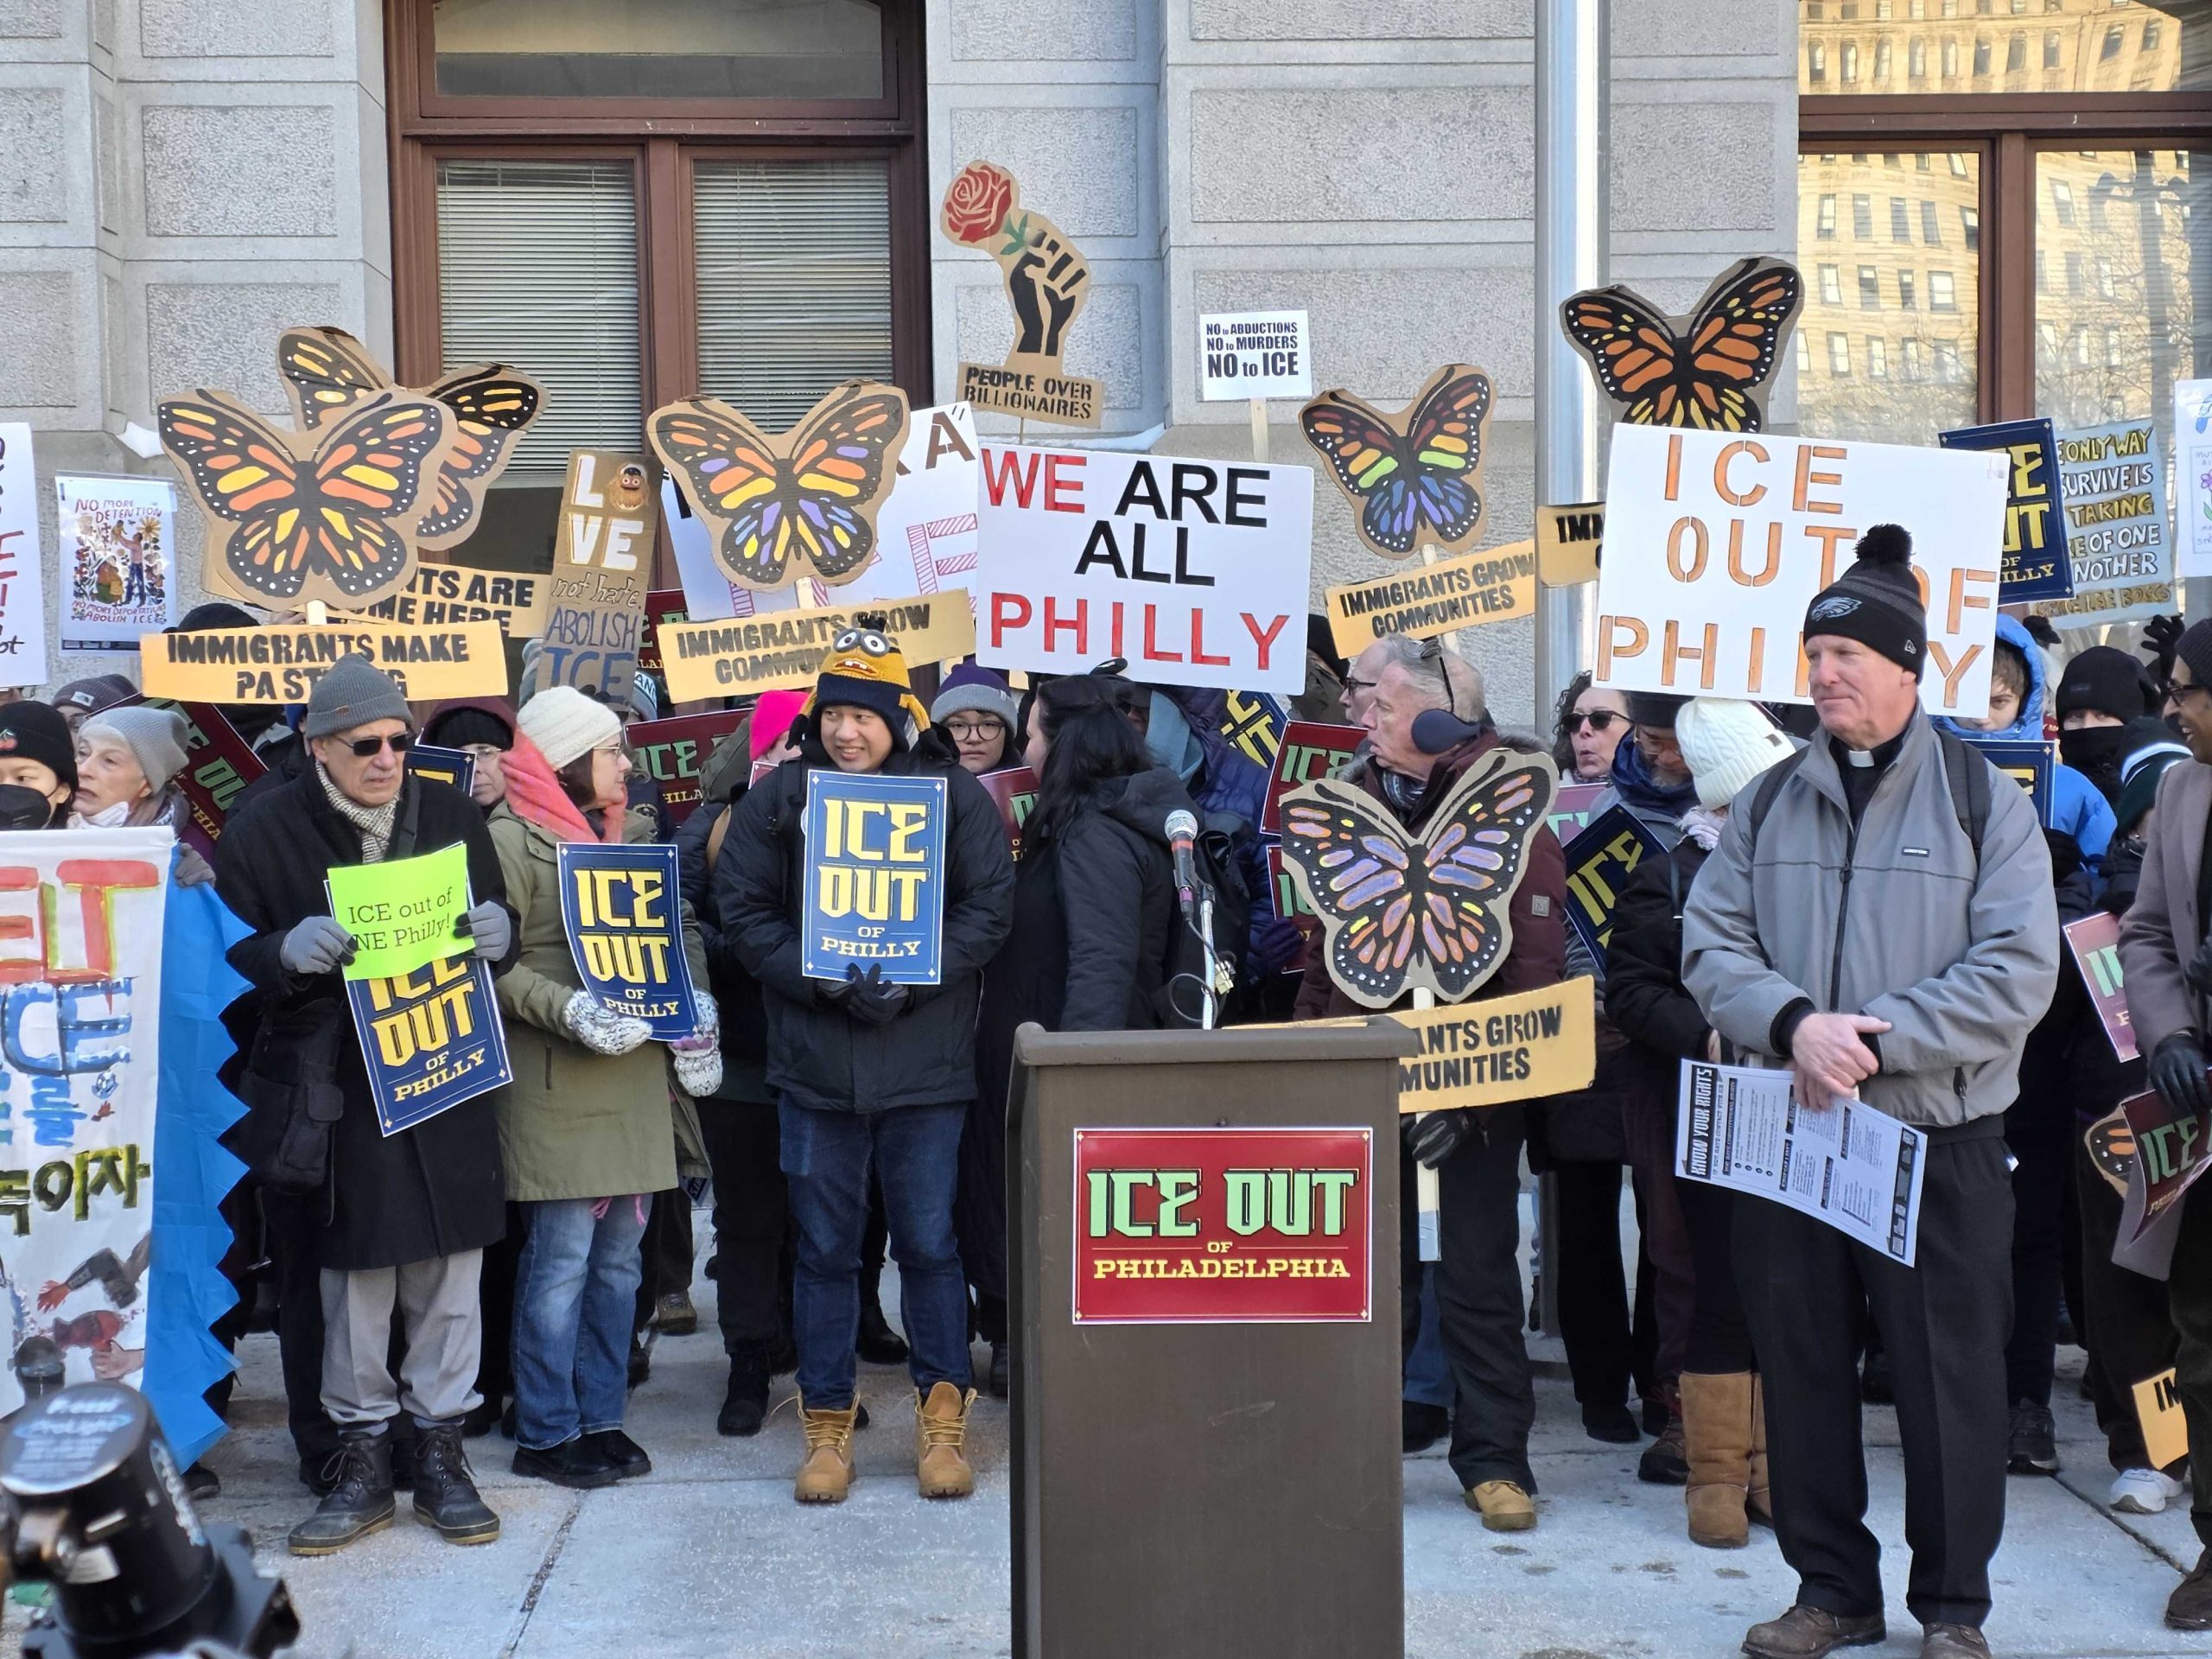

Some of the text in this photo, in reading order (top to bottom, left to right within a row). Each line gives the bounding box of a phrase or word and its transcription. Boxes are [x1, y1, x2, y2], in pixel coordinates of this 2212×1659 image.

[1206, 323, 1221, 335] NO
[1230, 322, 1298, 335] ABDUCTIONS
[1207, 337, 1224, 351] NO
[1236, 335, 1298, 350] MURDERS
[1208, 352, 1299, 378] NO to ICE
[966, 366, 1092, 401] PEOPLE OVER
[964, 385, 1091, 419] BILLIONAIRES
[2066, 434, 2112, 463] ONLY
[2116, 427, 2152, 455] WAY
[981, 448, 1270, 528] WE ARE
[1664, 434, 1848, 514] ICE
[2135, 463, 2153, 486] IS
[75, 499, 135, 513] NO MORE
[96, 507, 162, 524] DETENTION
[2070, 493, 2152, 528] TAKING
[1074, 519, 1215, 587] ALL
[1667, 516, 1858, 594] OUT
[2089, 530, 2113, 552] OF
[2118, 524, 2160, 550] ONE
[2075, 551, 2158, 583] NOTHER
[465, 575, 534, 607] ARE
[551, 571, 591, 599] not
[1339, 552, 1535, 619] IMMIGRANTS GROW
[86, 611, 126, 623] ABOLISH
[545, 607, 638, 650] ABOLISH
[1372, 584, 1516, 639] COMMUNITIES
[168, 633, 469, 664] IMMIGRANTS MAKE
[677, 614, 846, 659] IMMIGRANTS
[991, 592, 1290, 671] PHILLY
[715, 646, 831, 684] COMMUN
[237, 671, 276, 700] PA
[194, 756, 248, 811] OU
[823, 797, 931, 862] ICE
[348, 887, 453, 925] ICE out of
[573, 868, 666, 928] ICE
[817, 863, 931, 921] OUT
[395, 913, 450, 948] Philly!
[821, 936, 921, 958] PHILLY
[857, 926, 886, 938] OF
[578, 932, 671, 984] OUT
[603, 997, 679, 1018] PHILLY
[625, 988, 646, 1001] OF
[371, 981, 475, 1067] OUT
[1486, 1005, 1562, 1047] GROW
[394, 1048, 486, 1102] PHILLY
[426, 1051, 449, 1071] OF
[1399, 1046, 1531, 1093] MUNITIES
[1691, 1068, 1712, 1175] KNOW YOUR RIGHTS
[2140, 1115, 2199, 1185] ICE
[1087, 1167, 1359, 1237] ICE OUT
[1207, 1242, 1233, 1254] OF
[1094, 1259, 1351, 1279] PHILADELPHIA
